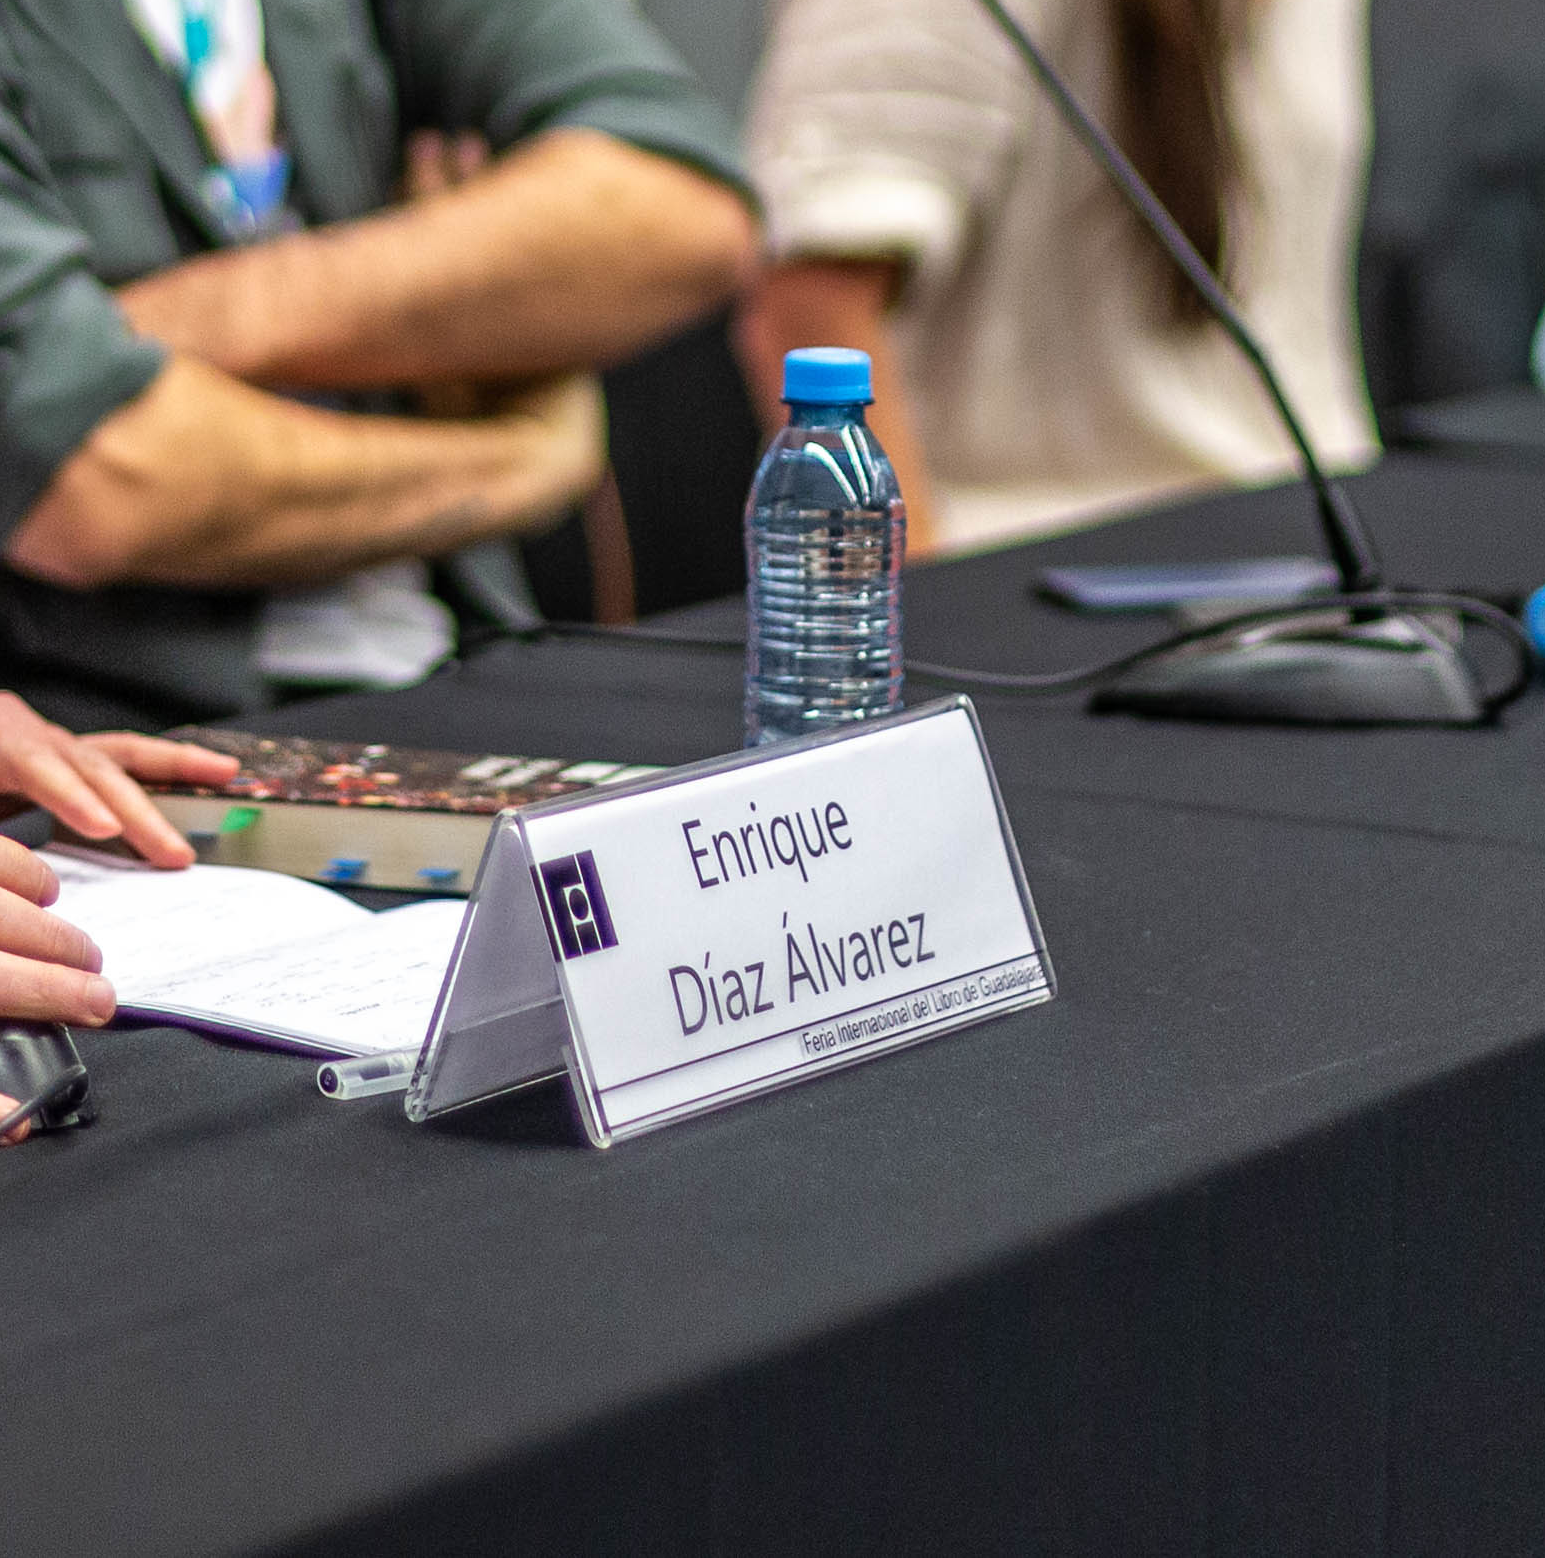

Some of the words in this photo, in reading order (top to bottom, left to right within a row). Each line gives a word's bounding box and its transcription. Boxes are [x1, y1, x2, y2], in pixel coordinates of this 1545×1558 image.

[682, 801, 853, 889] Enrique
[668, 951, 775, 1036] Díaz
[782, 911, 936, 1003] Álvarez
[802, 1028, 835, 1054] Feria
[837, 1002, 911, 1043] Internacional
[913, 998, 931, 1018] del
[933, 989, 962, 1013] Libro
[963, 982, 979, 1004] de
